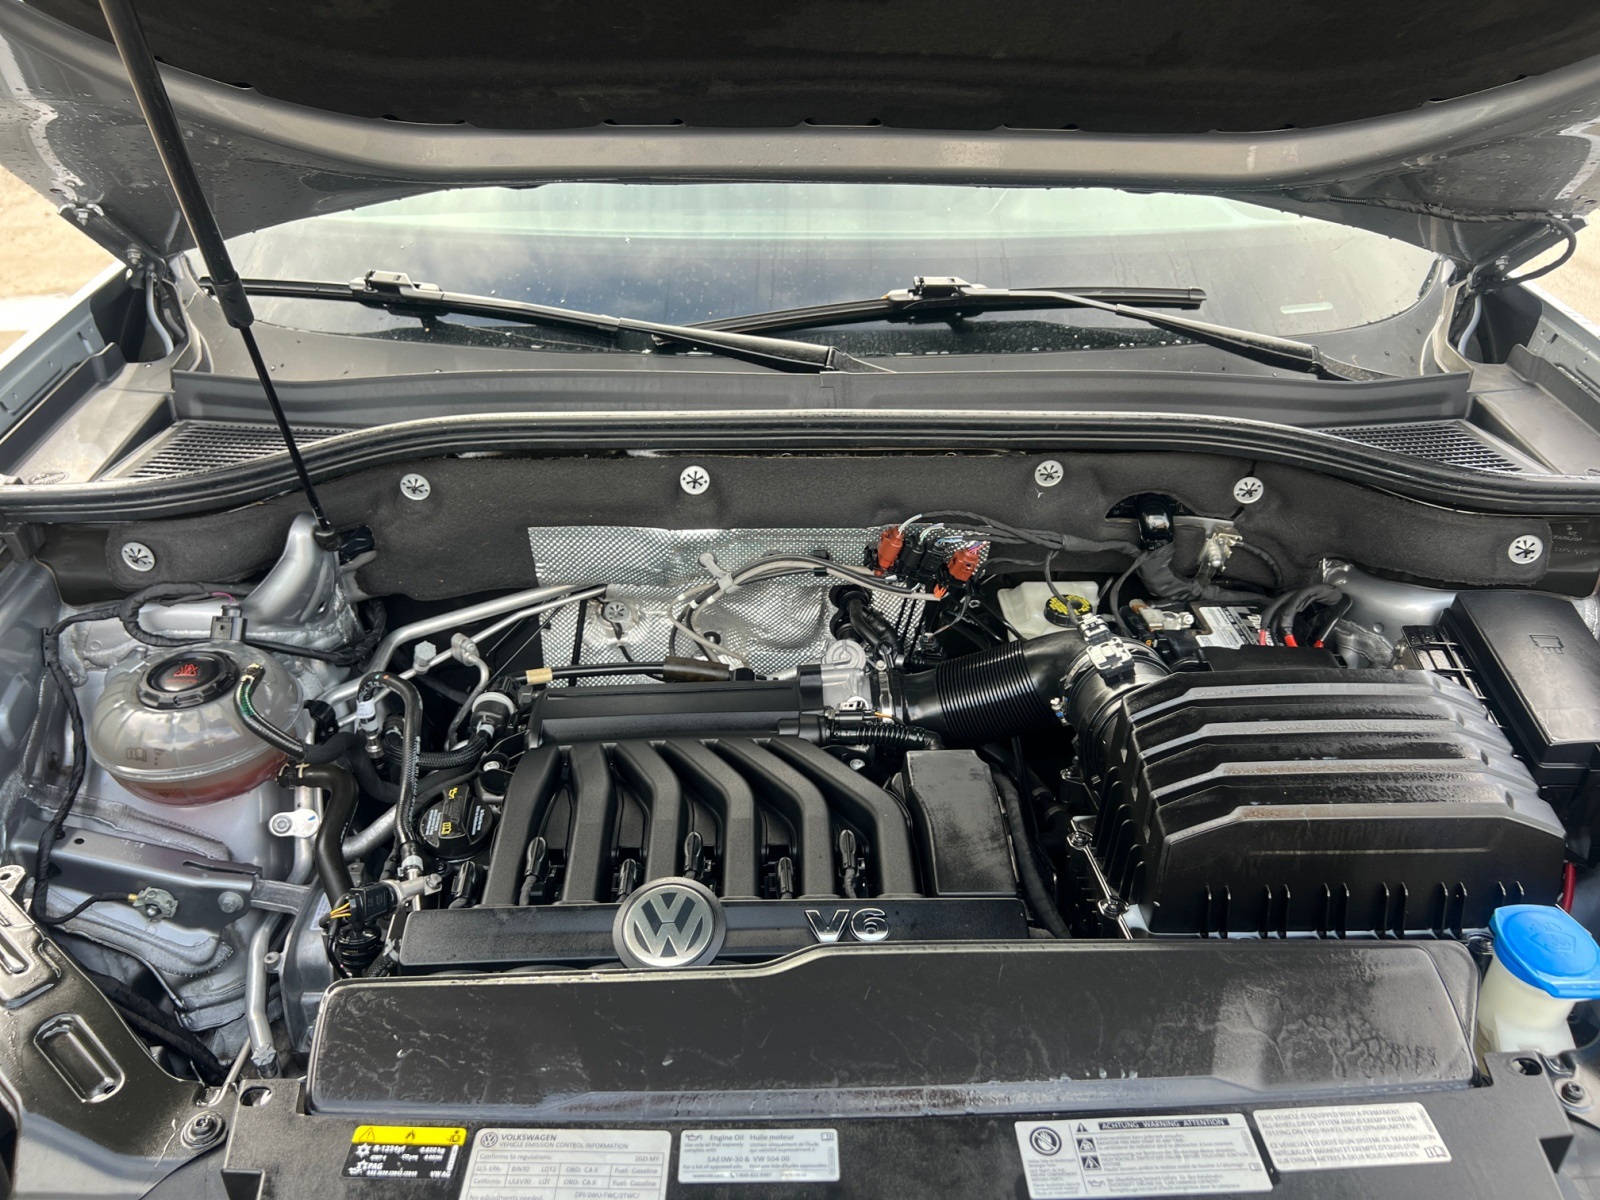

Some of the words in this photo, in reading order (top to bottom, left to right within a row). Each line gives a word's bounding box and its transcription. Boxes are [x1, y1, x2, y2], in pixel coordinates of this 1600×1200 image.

[804, 907, 890, 942] V6
[1101, 1120, 1140, 1130] ACHTUNG
[1142, 1119, 1181, 1128] WARNING
[1183, 1117, 1225, 1127] ATTENTION
[710, 1134, 733, 1142] Engine
[734, 1133, 744, 1141] Oil
[373, 1144, 407, 1155] R-1234yf
[585, 1142, 629, 1150] INFORMATION
[367, 1162, 384, 1170] PAG
[430, 1170, 442, 1179] VW
[441, 1171, 451, 1179] AG
